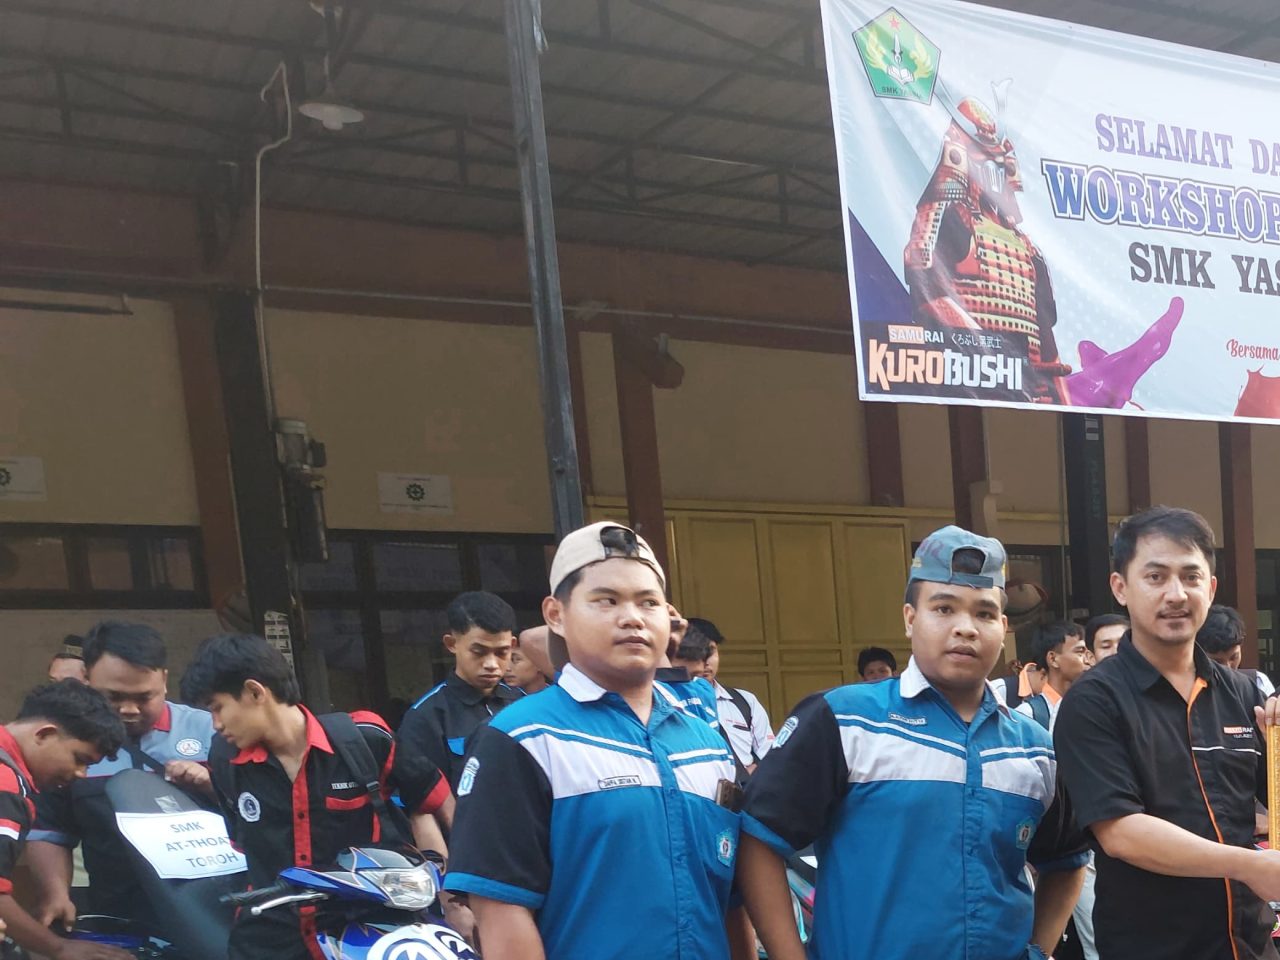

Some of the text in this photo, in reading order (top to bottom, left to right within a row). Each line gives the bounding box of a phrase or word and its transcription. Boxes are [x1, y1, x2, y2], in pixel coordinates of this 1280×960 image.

[1095, 113, 1233, 169] SELAMAT
[1128, 242, 1215, 289] SMK
[888, 326, 944, 345] SAMURAI
[1226, 339, 1280, 362] Bersama
[868, 338, 1023, 391] KUROBUSHI
[170, 821, 204, 833] SMK
[185, 852, 239, 868] TOROH
